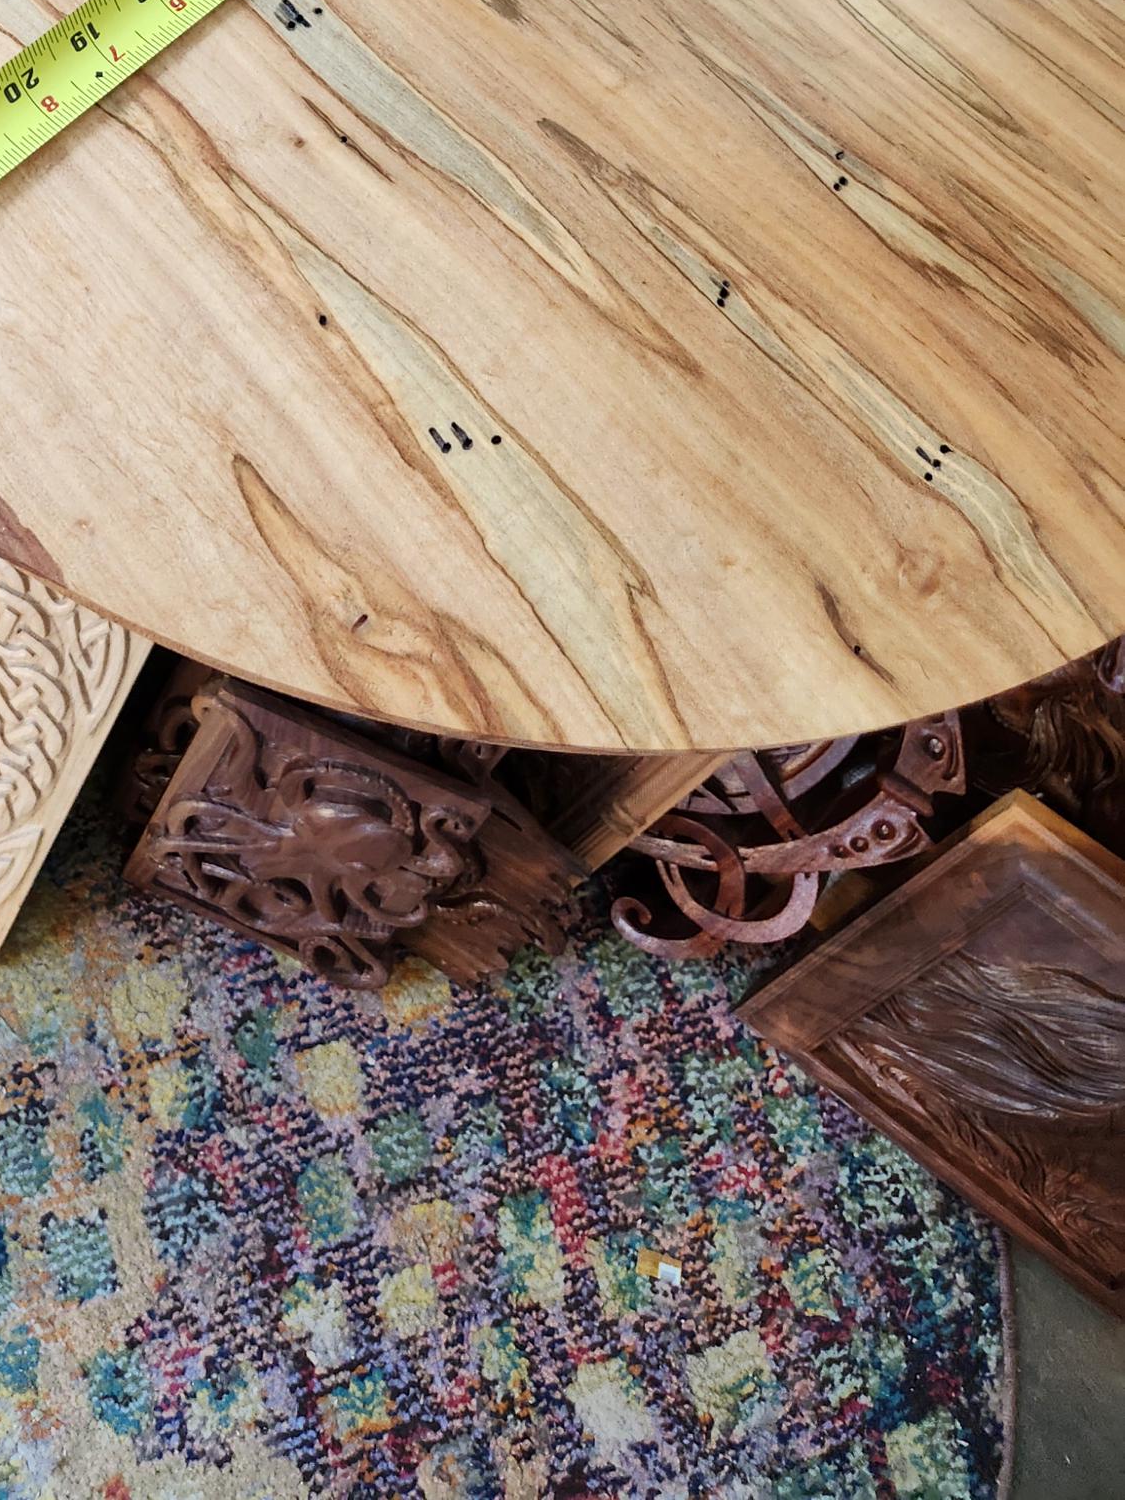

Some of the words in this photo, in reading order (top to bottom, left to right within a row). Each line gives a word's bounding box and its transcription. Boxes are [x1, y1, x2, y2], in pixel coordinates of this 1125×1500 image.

[70, 22, 101, 52] 19
[109, 45, 126, 63] 7
[3, 67, 39, 104] 20
[40, 95, 59, 112] 8
